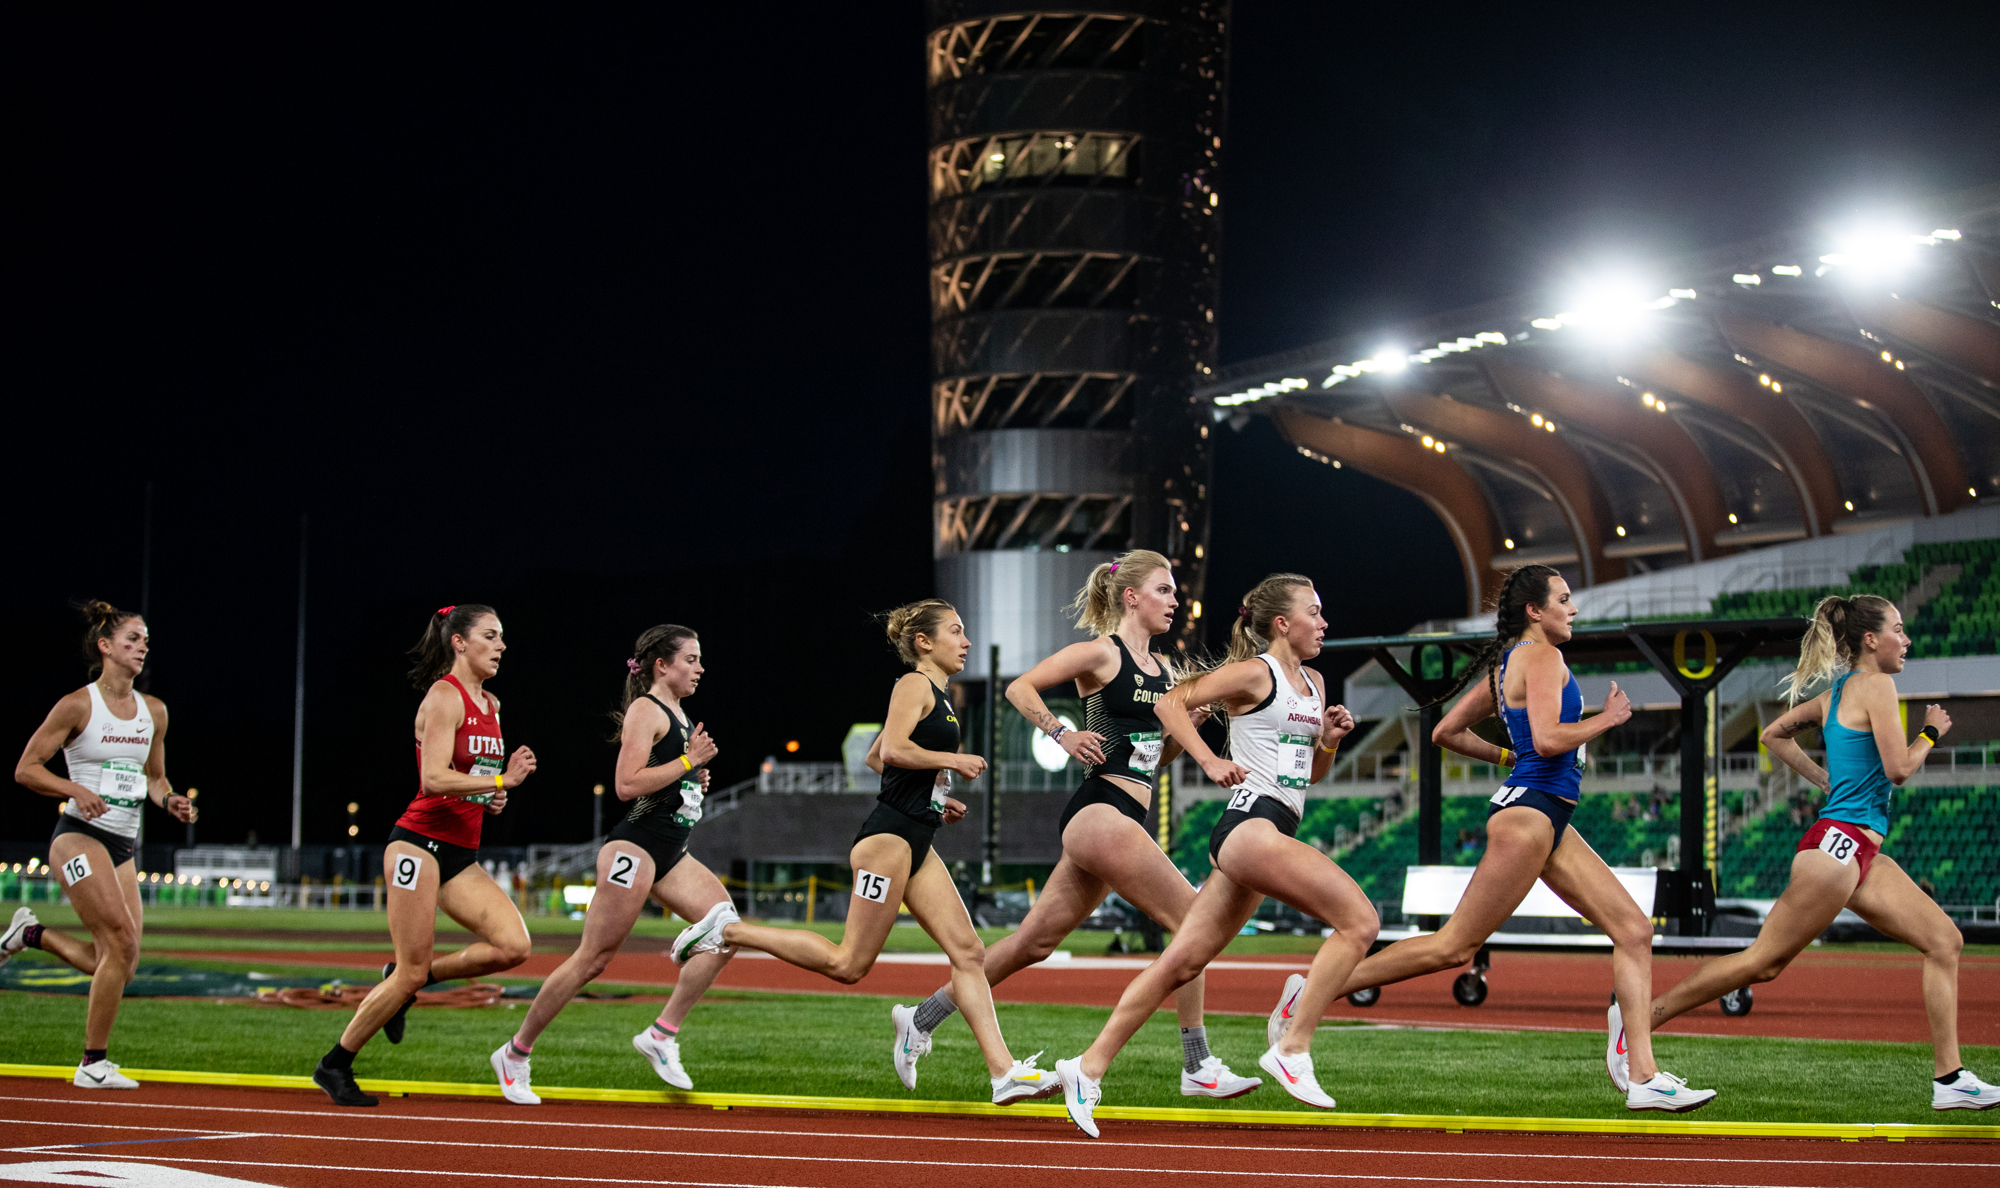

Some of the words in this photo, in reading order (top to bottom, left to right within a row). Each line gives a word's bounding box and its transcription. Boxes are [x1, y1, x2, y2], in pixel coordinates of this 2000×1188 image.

[1674, 629, 1717, 680] O
[101, 735, 150, 746] ARKANSAS
[1231, 789, 1252, 808] 13
[1828, 833, 1853, 860] 18
[66, 858, 86, 881] 16
[397, 858, 416, 885] 9
[610, 856, 633, 885] 2
[862, 873, 886, 900] 15
